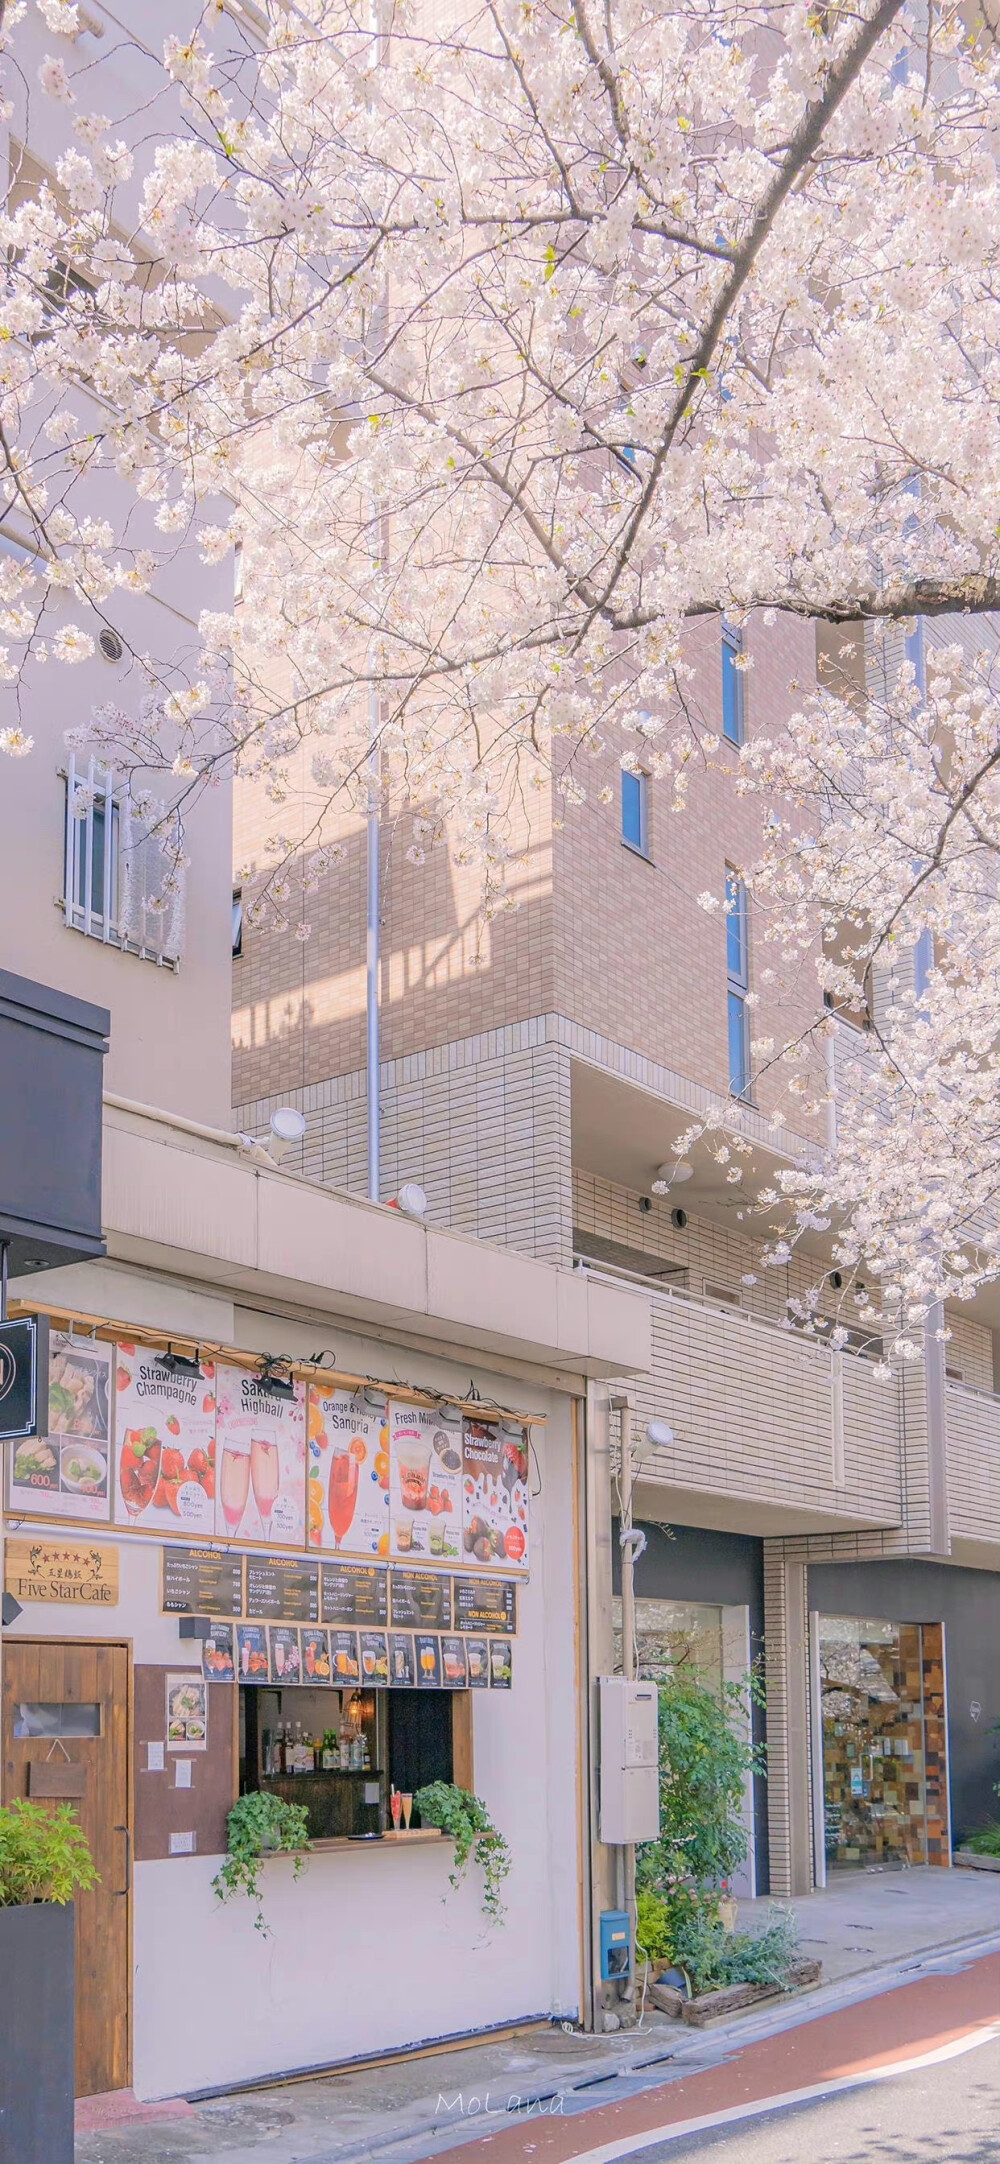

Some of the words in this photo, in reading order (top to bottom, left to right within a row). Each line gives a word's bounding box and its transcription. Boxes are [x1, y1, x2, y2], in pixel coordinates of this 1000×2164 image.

[139, 1365, 197, 1392] Strawberry
[136, 1381, 197, 1406] Champagne
[241, 1379, 282, 1402] Sak
[241, 1398, 284, 1419] Highball
[323, 1401, 348, 1413] Orange
[332, 1415, 369, 1434] Sangria
[395, 1412, 417, 1425] Fresh
[464, 1433, 502, 1452] Strawberry
[464, 1446, 499, 1464] Chocolate
[189, 1549, 222, 1560] ALCOHOL
[268, 1558, 299, 1568] ALCOHOL
[340, 1565, 368, 1575] ALCOHOL
[415, 1573, 438, 1582] ALCOHOL
[17, 1578, 47, 1597] Five
[50, 1580, 79, 1598] Star
[79, 1583, 112, 1601] Cafe
[480, 1611, 501, 1620] ALCOHOL
